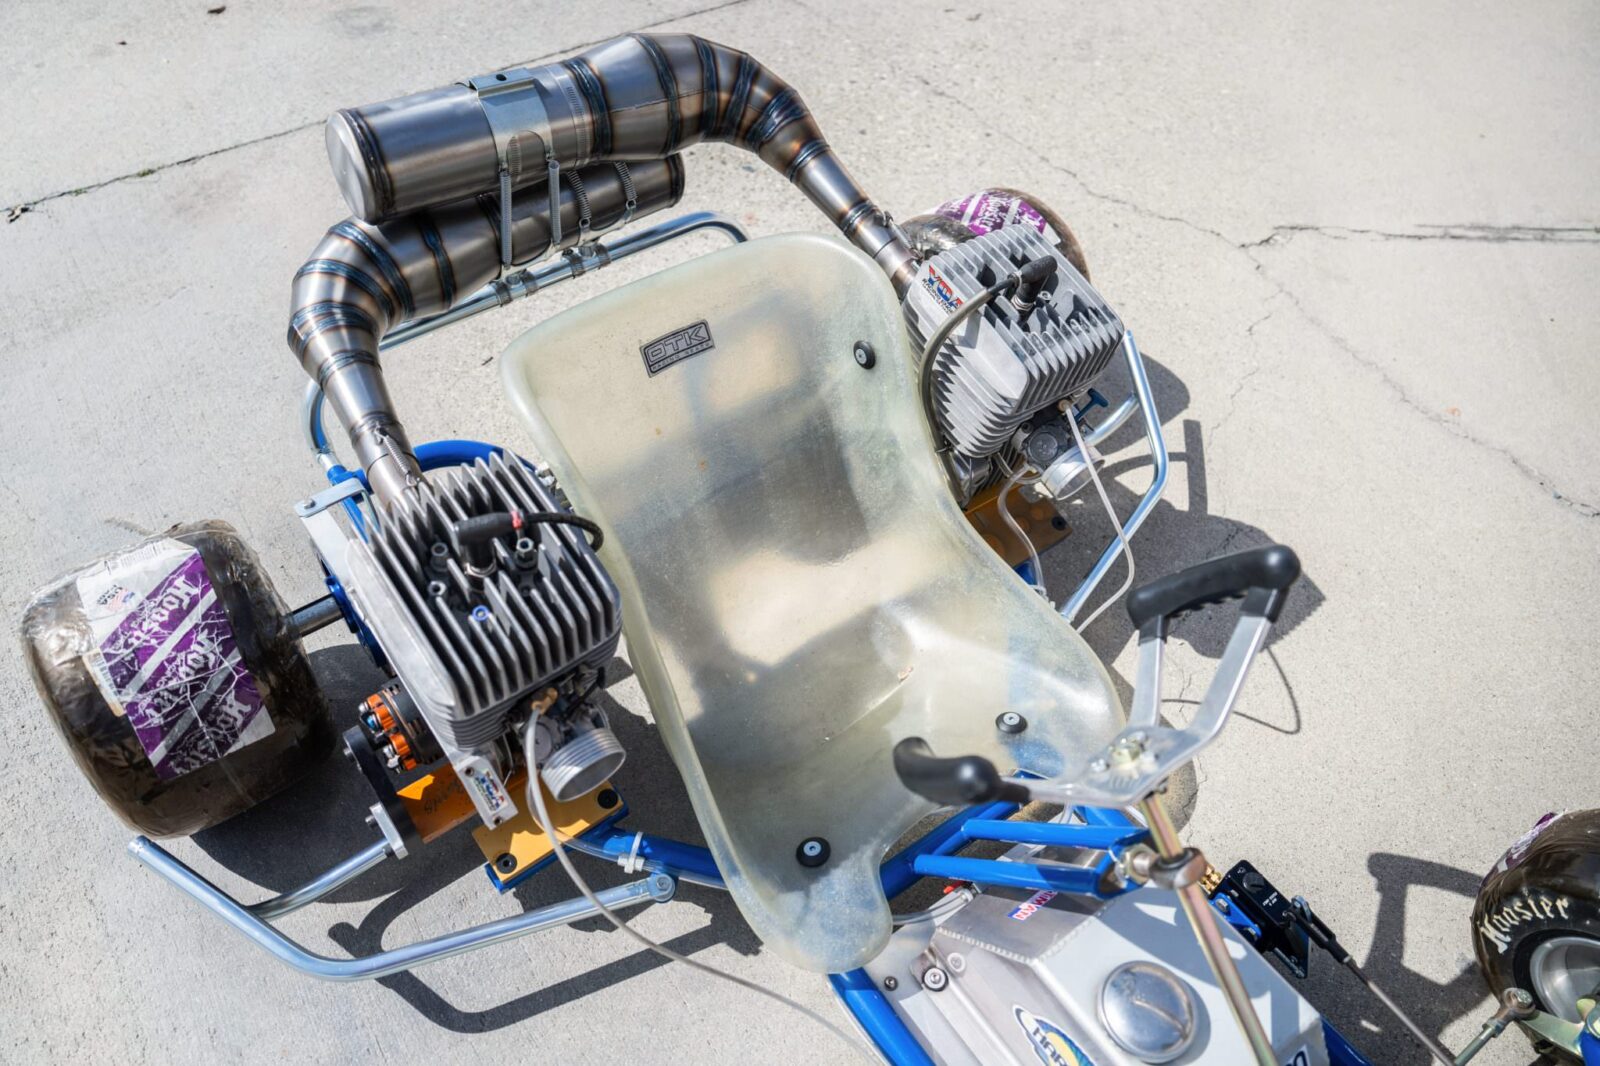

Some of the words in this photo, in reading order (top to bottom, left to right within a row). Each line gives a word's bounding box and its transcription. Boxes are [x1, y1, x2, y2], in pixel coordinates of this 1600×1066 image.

[646, 325, 706, 363] OTK
[651, 354, 680, 370] RACING
[1480, 889, 1569, 954] Hoosier
